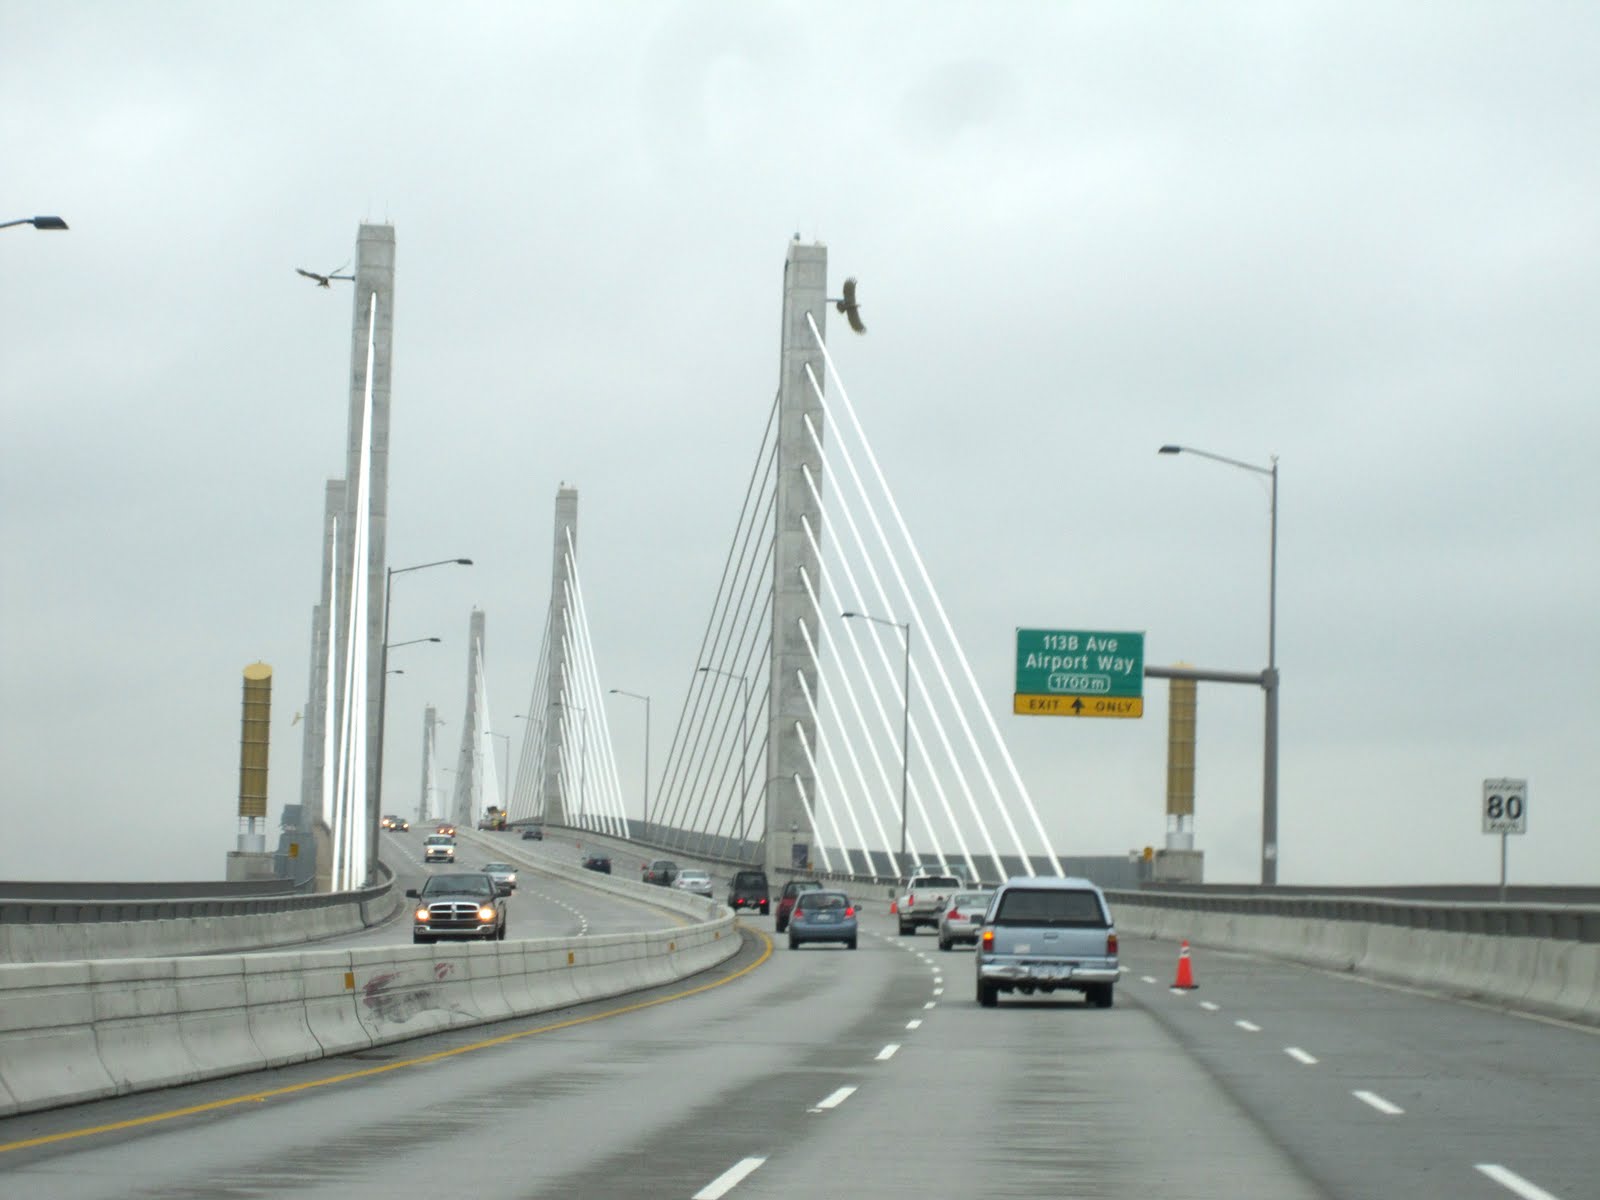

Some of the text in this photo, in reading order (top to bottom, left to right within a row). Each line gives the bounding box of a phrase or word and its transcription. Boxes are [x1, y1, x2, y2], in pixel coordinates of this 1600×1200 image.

[1043, 635, 1118, 652] 113B Ave
[1025, 653, 1135, 675] Airport Way
[1029, 699, 1133, 712] EXIT ONLY
[1487, 795, 1522, 819] 80
